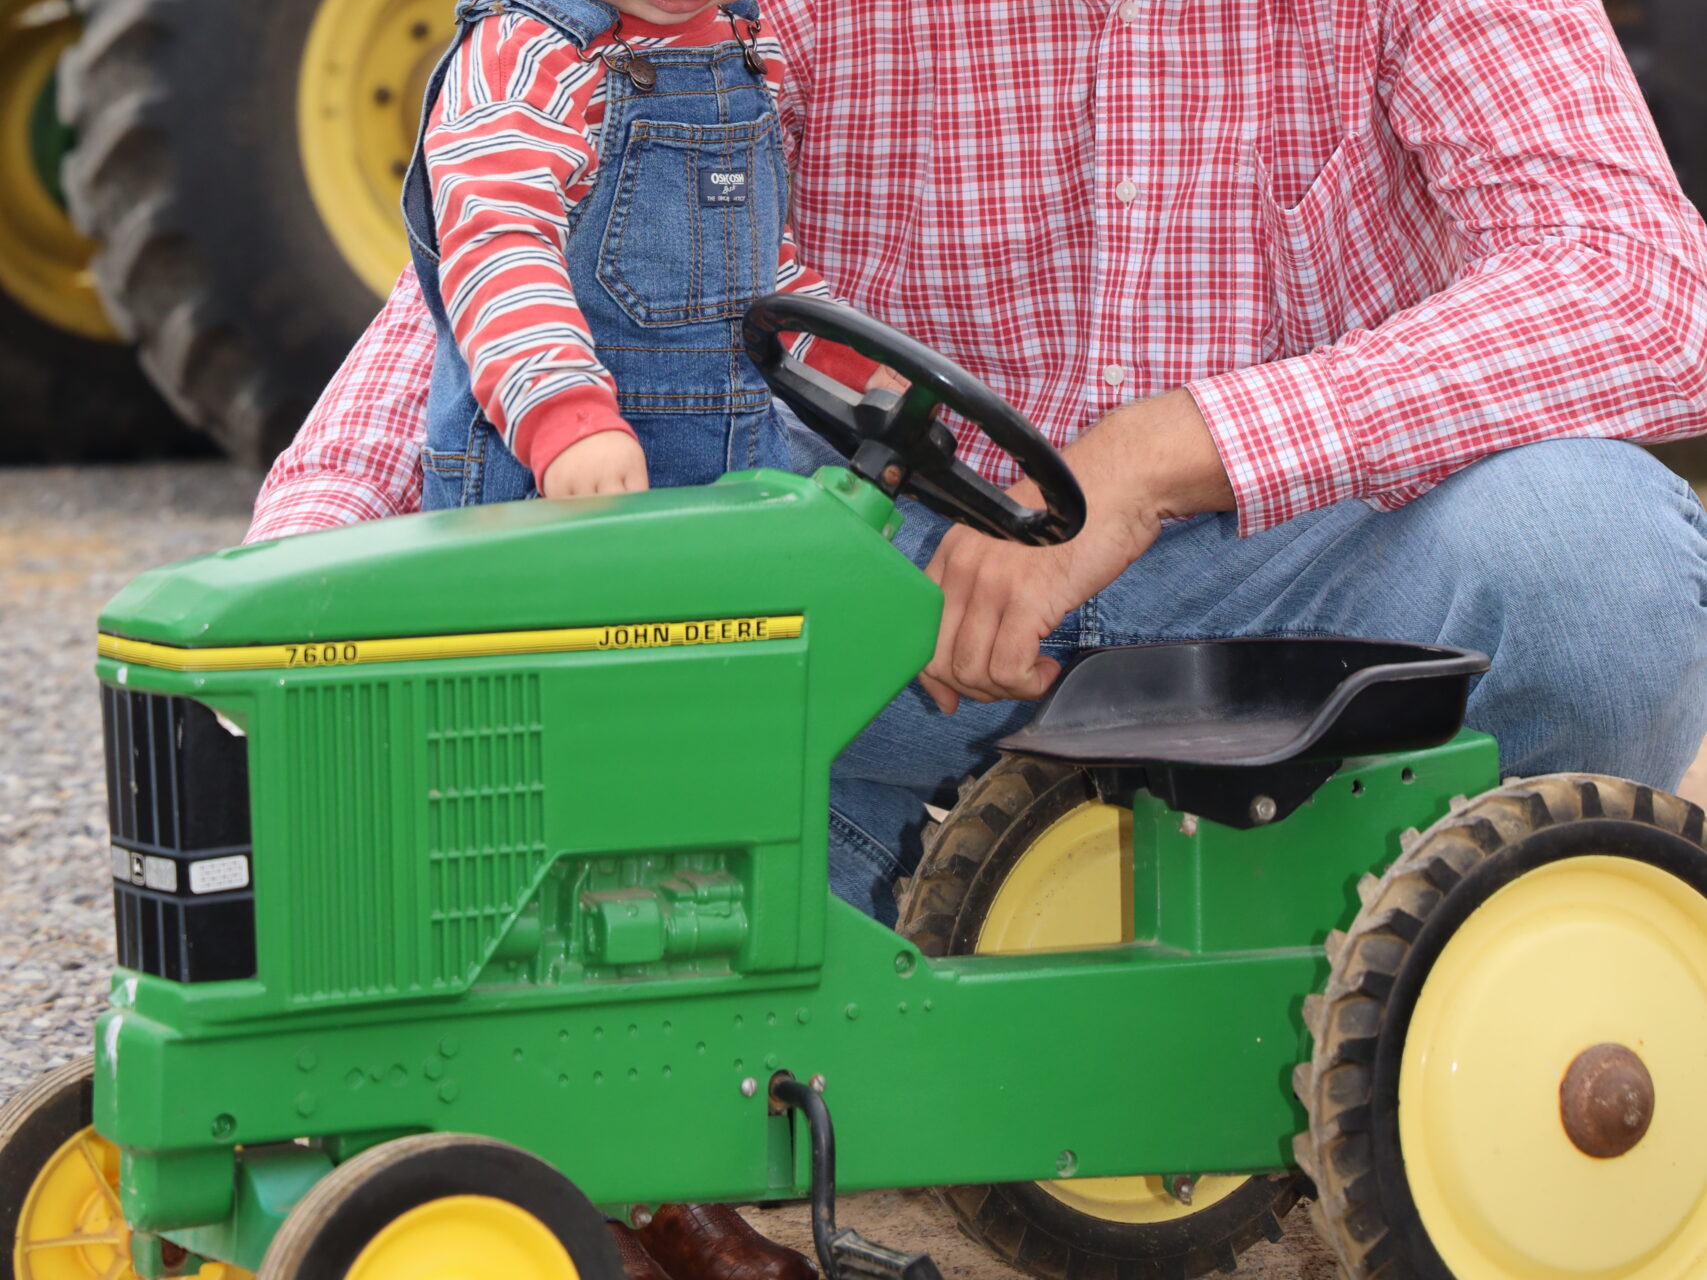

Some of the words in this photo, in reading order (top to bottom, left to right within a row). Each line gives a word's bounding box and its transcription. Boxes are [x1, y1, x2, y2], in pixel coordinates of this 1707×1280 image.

[599, 624, 669, 647] JOHN
[685, 619, 768, 642] DEERE
[285, 643, 358, 666] 7600
